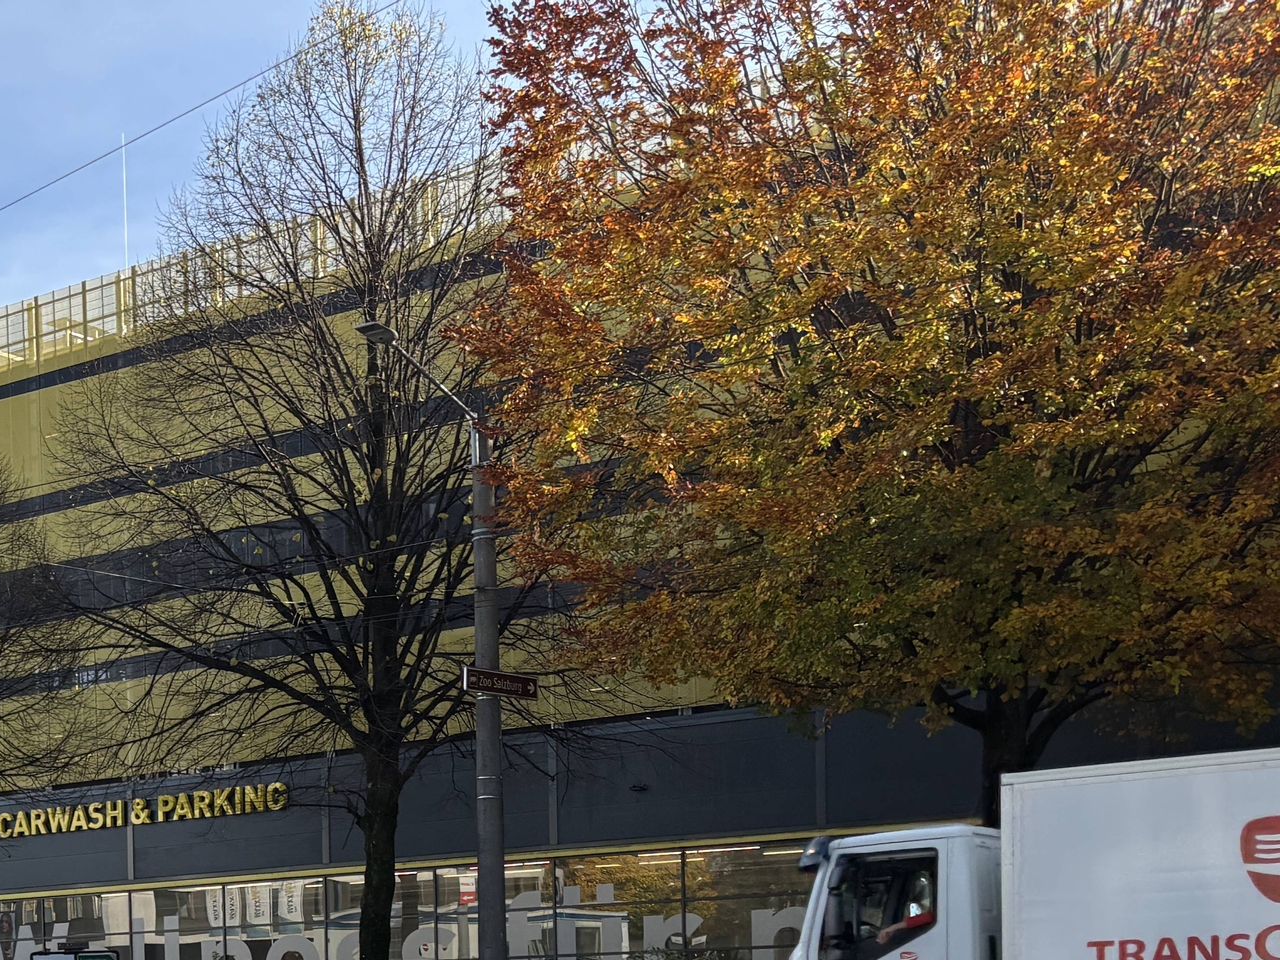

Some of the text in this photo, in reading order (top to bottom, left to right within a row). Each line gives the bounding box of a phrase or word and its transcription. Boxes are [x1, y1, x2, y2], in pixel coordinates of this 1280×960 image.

[479, 675, 523, 694] Zoo Salzburg
[130, 798, 152, 826] &
[157, 781, 289, 822] PARKING
